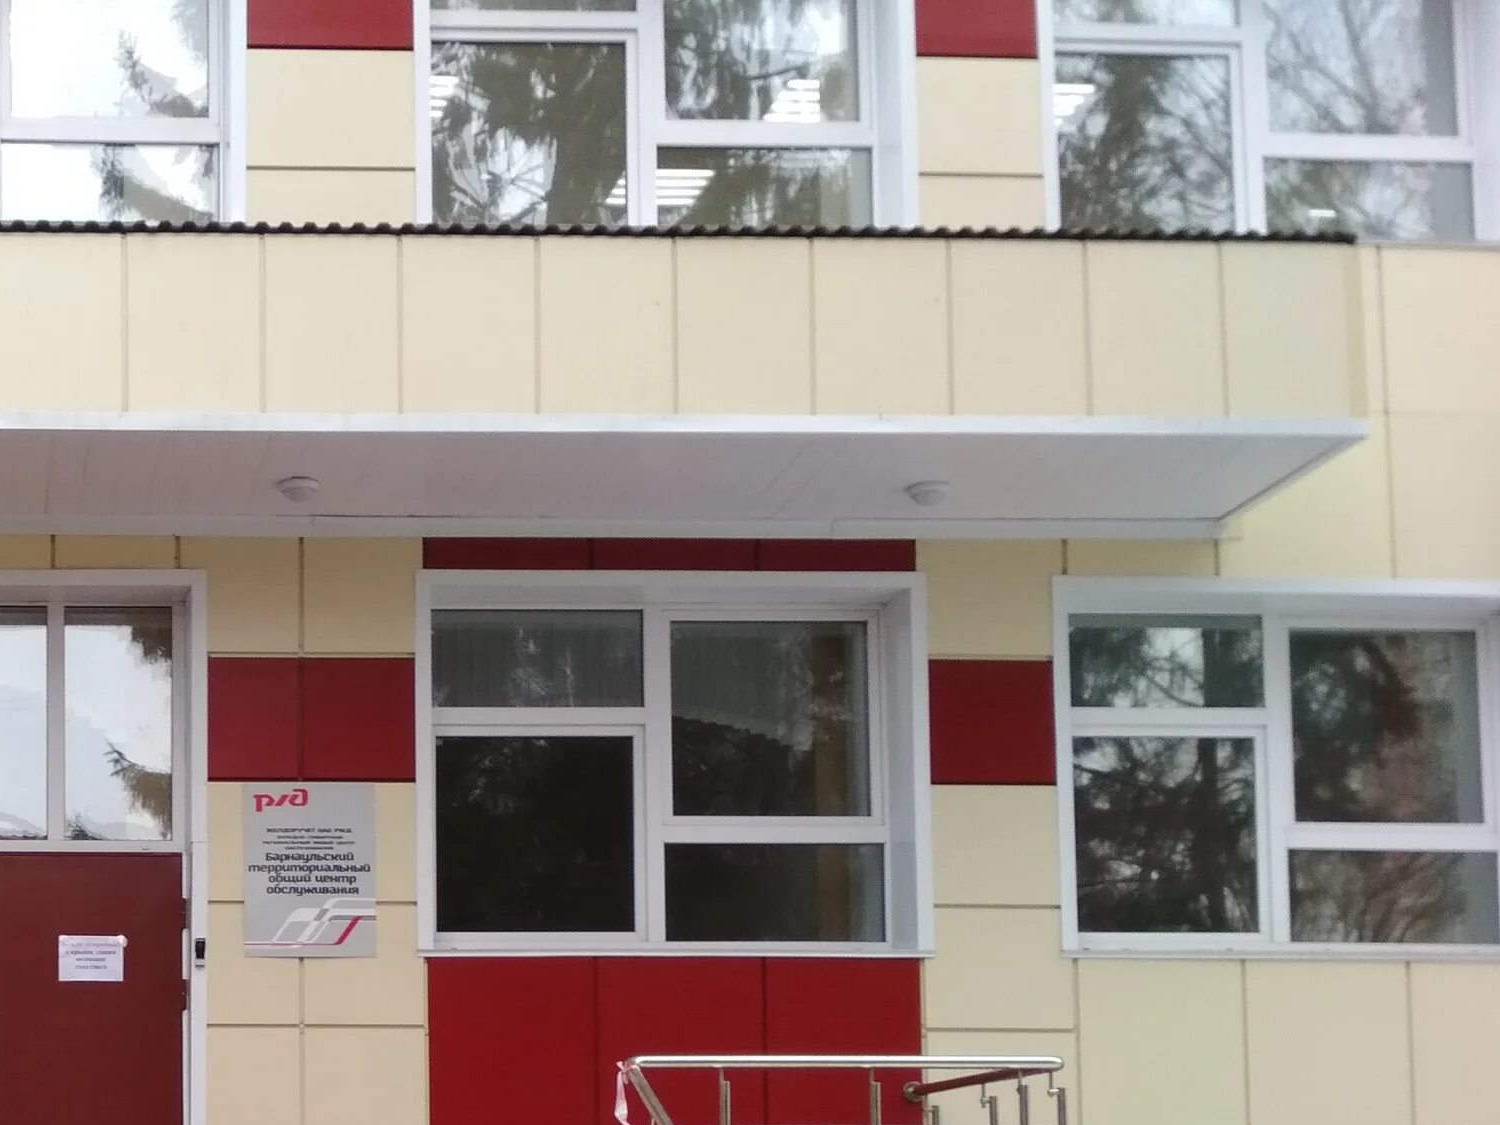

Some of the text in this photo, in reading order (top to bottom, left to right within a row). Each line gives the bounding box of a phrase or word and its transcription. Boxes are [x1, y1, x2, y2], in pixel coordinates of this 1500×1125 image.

[265, 852, 354, 863] Барнаульский
[248, 863, 371, 874] территориальный
[268, 873, 357, 885] общий центр
[266, 884, 359, 896] обслуживания
